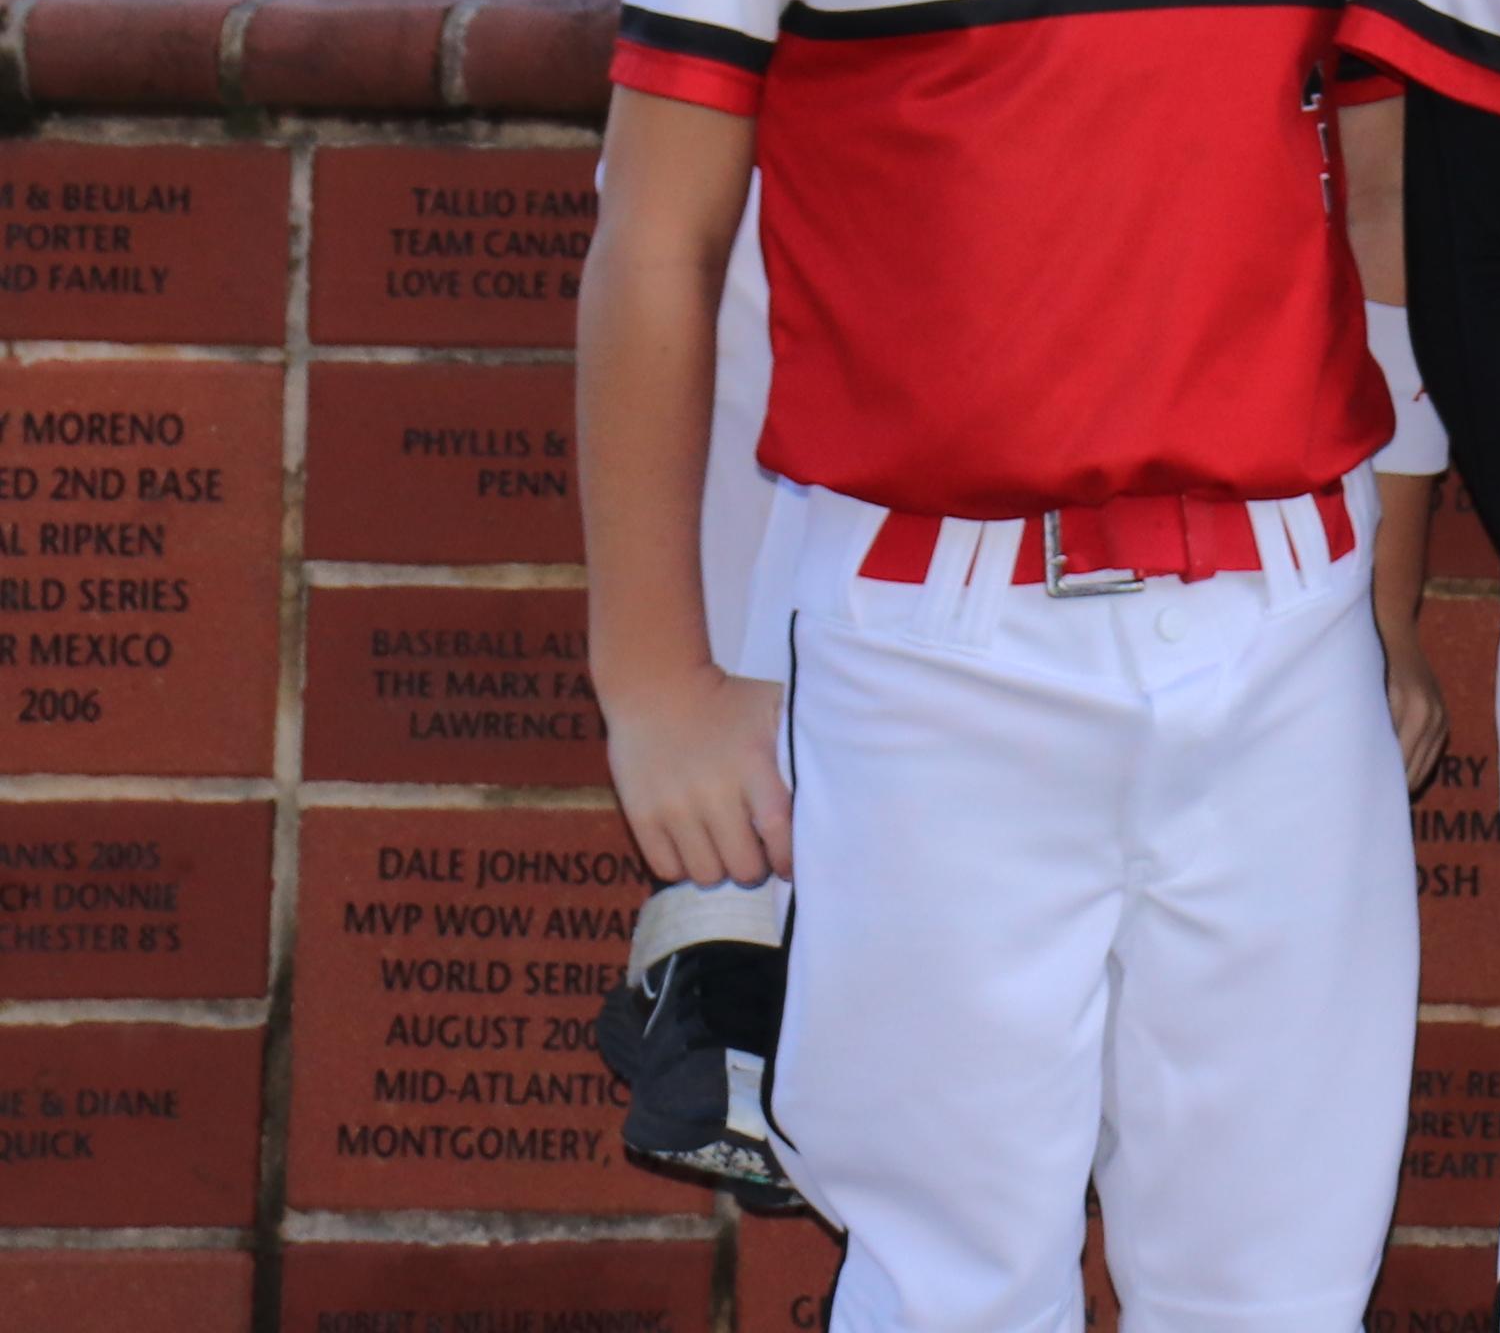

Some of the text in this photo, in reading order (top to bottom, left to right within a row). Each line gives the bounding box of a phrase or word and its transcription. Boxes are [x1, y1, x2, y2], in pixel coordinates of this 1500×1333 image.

[61, 184, 191, 213] BEULAH
[412, 187, 597, 218] TALLIO FAMI
[5, 223, 131, 253] PORTER
[391, 228, 588, 260] TEAM CANAD
[48, 265, 167, 294] FAMILY
[387, 270, 460, 299] LOVE
[472, 271, 546, 300] COLE
[22, 412, 184, 447] MORENO
[402, 428, 532, 458] PHYLLIS
[50, 467, 126, 502] 2ND
[138, 468, 221, 503] BASE
[478, 469, 567, 498] PENN
[39, 523, 164, 557] RIPKEN
[0, 578, 189, 613] RLD SERIES
[29, 633, 173, 668] MEXICO
[372, 630, 528, 661] BASEBALL
[375, 670, 431, 699] THE
[446, 671, 539, 698] MARX
[19, 688, 101, 723] 2006
[410, 711, 586, 741] LAWRENCE
[89, 843, 160, 871] 2005
[378, 847, 463, 883] DALE
[53, 883, 176, 912] DONNIE
[344, 902, 423, 935] MVP
[433, 905, 533, 939] WOW
[381, 959, 513, 995] WORLD
[385, 1015, 603, 1055] AUGUST 200
[374, 1067, 632, 1109] MID-ATLANTIC
[76, 1090, 177, 1119] DIANE
[337, 1124, 610, 1166] MONTGOMERY,
